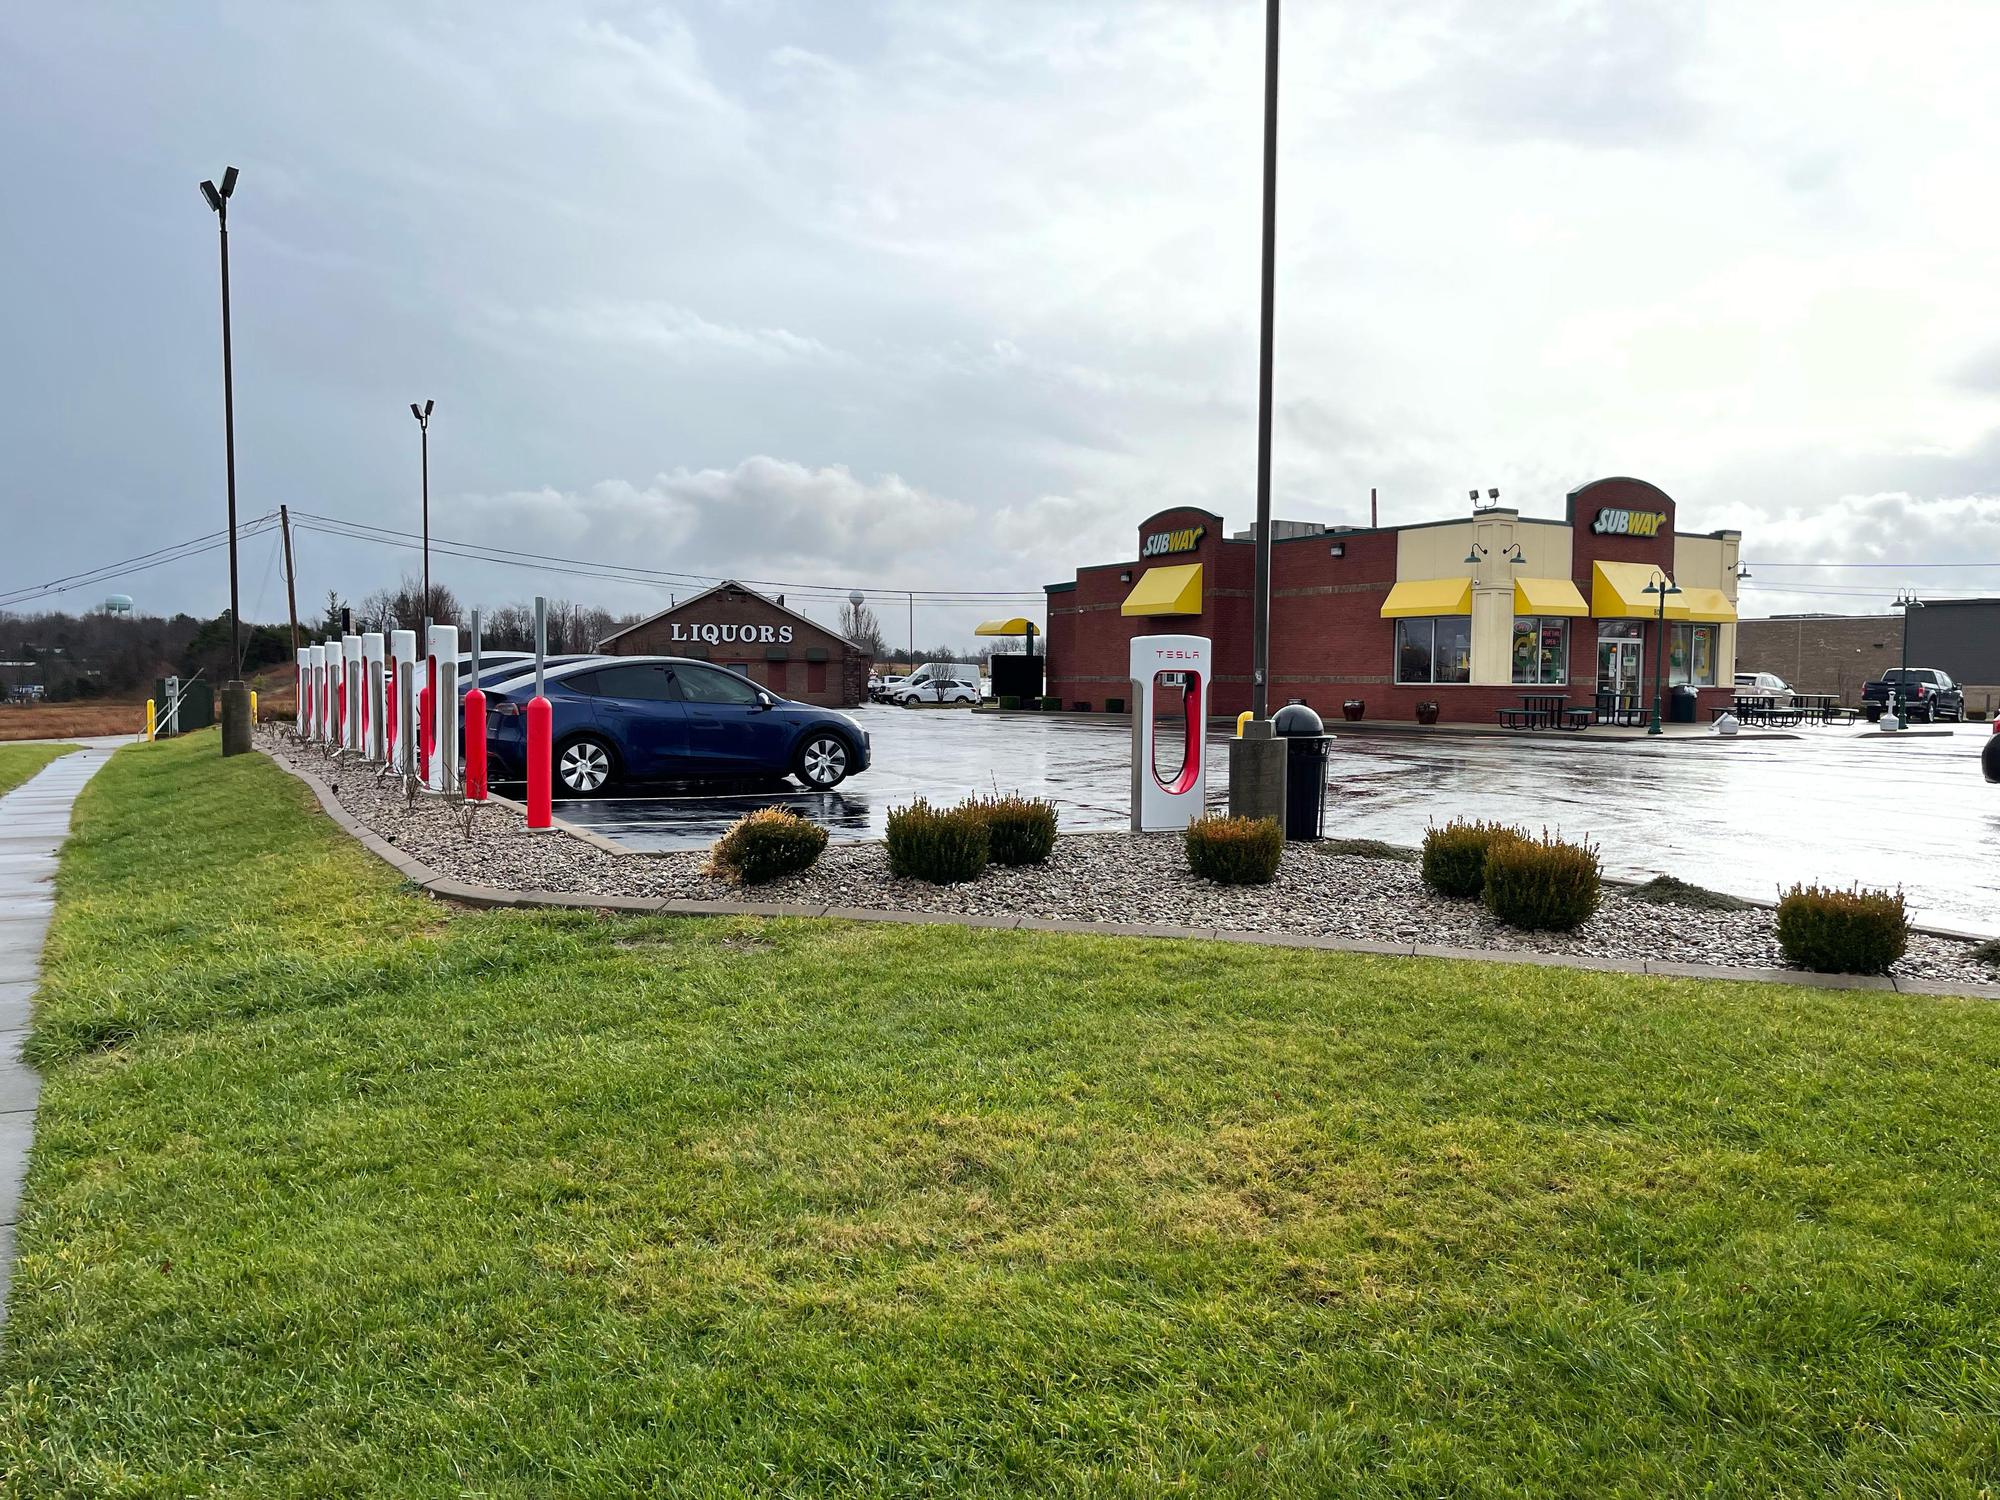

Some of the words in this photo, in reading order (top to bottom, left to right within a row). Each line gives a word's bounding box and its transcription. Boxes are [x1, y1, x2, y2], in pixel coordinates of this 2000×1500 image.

[1593, 509, 1666, 536] SUBWAY
[1143, 524, 1204, 556] SUBWAY
[671, 623, 793, 645] LIQUORS
[1156, 650, 1200, 659] TESLA
